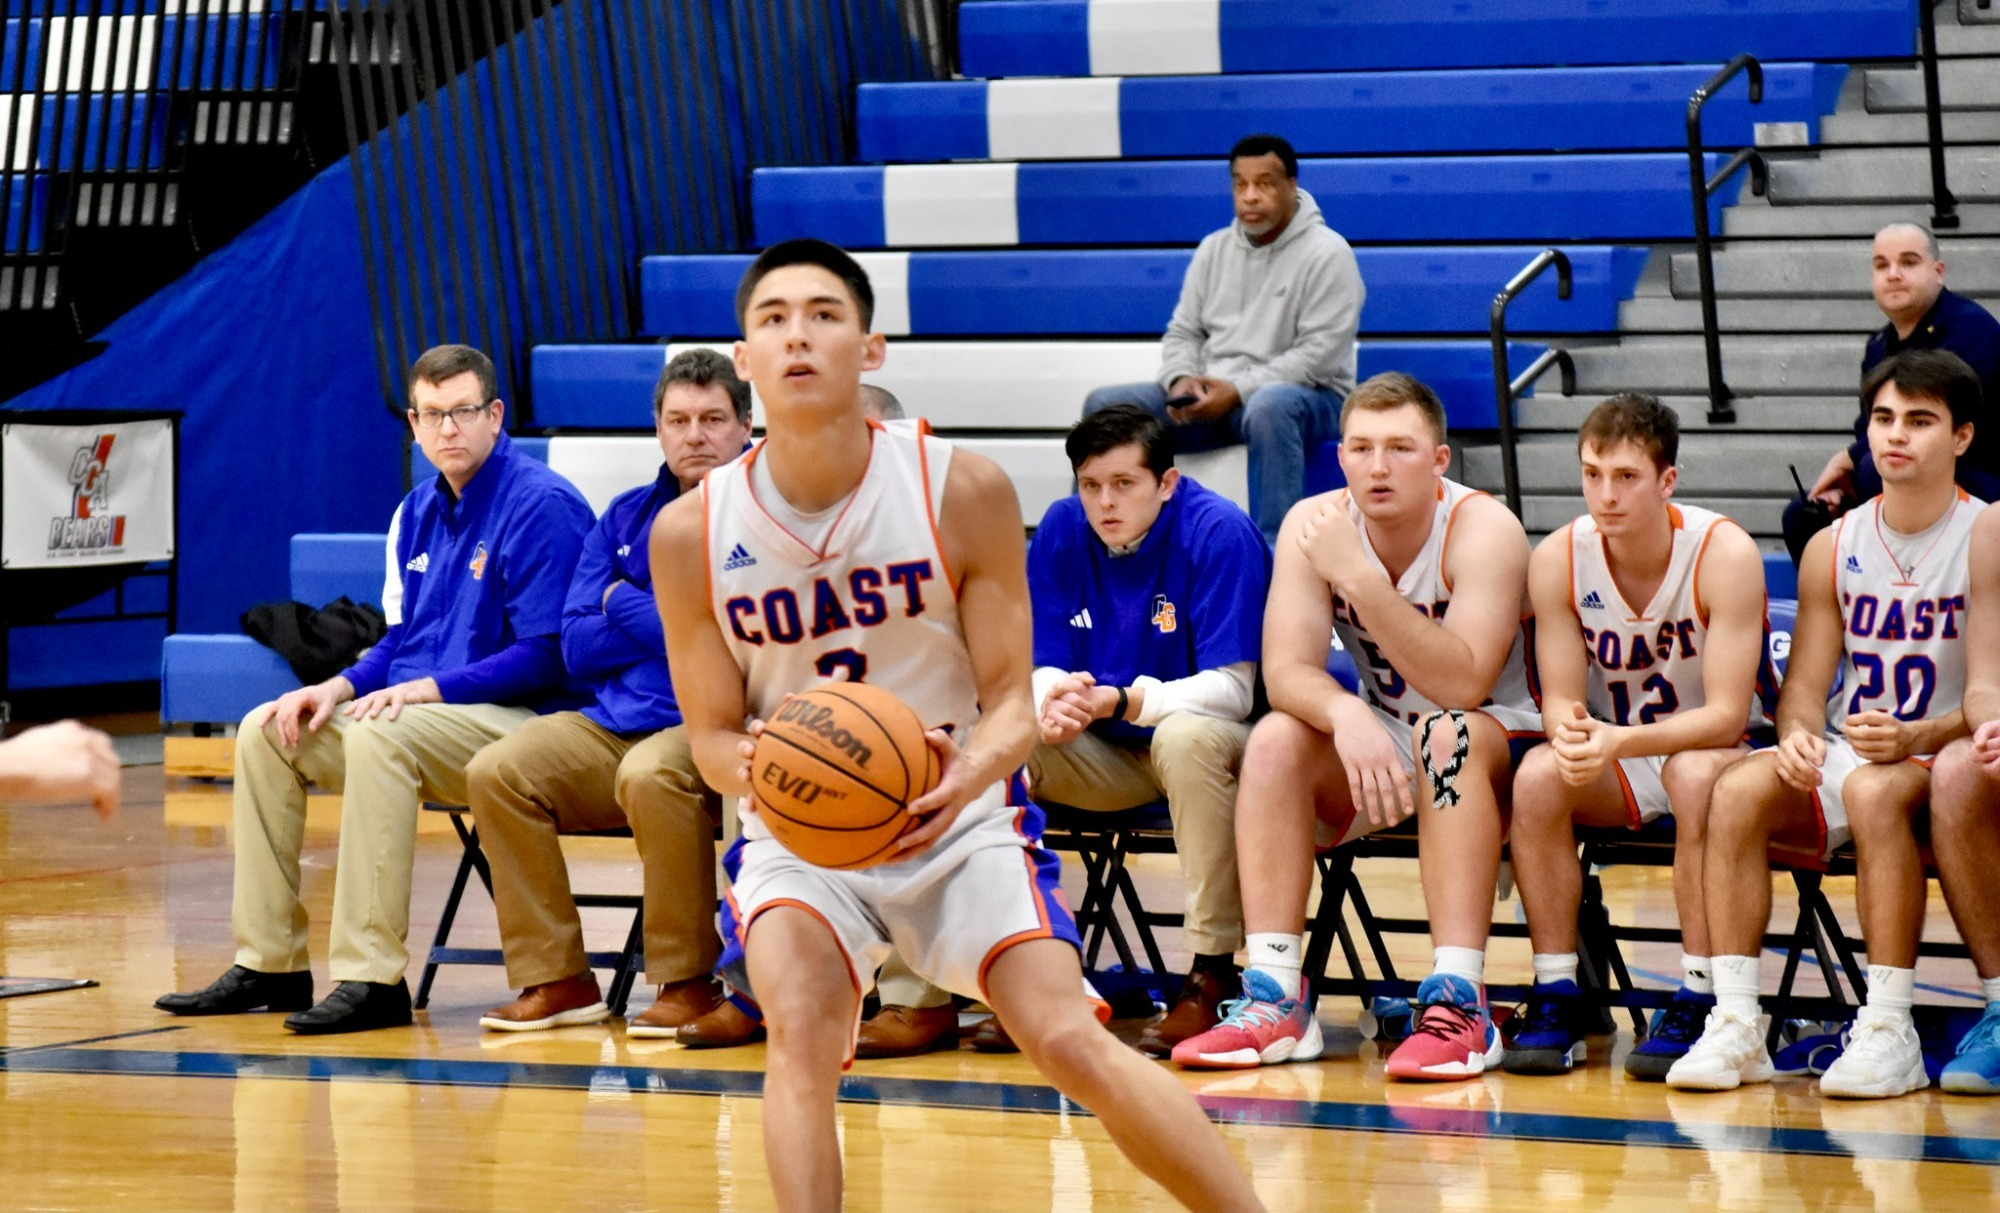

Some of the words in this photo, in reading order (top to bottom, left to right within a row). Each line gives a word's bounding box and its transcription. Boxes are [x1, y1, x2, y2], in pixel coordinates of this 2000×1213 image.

[47, 515, 110, 550] BEARS
[723, 557, 758, 571] adidas
[725, 557, 934, 647] COAST
[1580, 601, 1605, 610] adidas
[1843, 594, 1966, 641] OAST
[1607, 672, 1680, 726] 12
[1847, 650, 1937, 722] 20
[775, 698, 874, 772] Wilson
[761, 761, 823, 805] EVO
